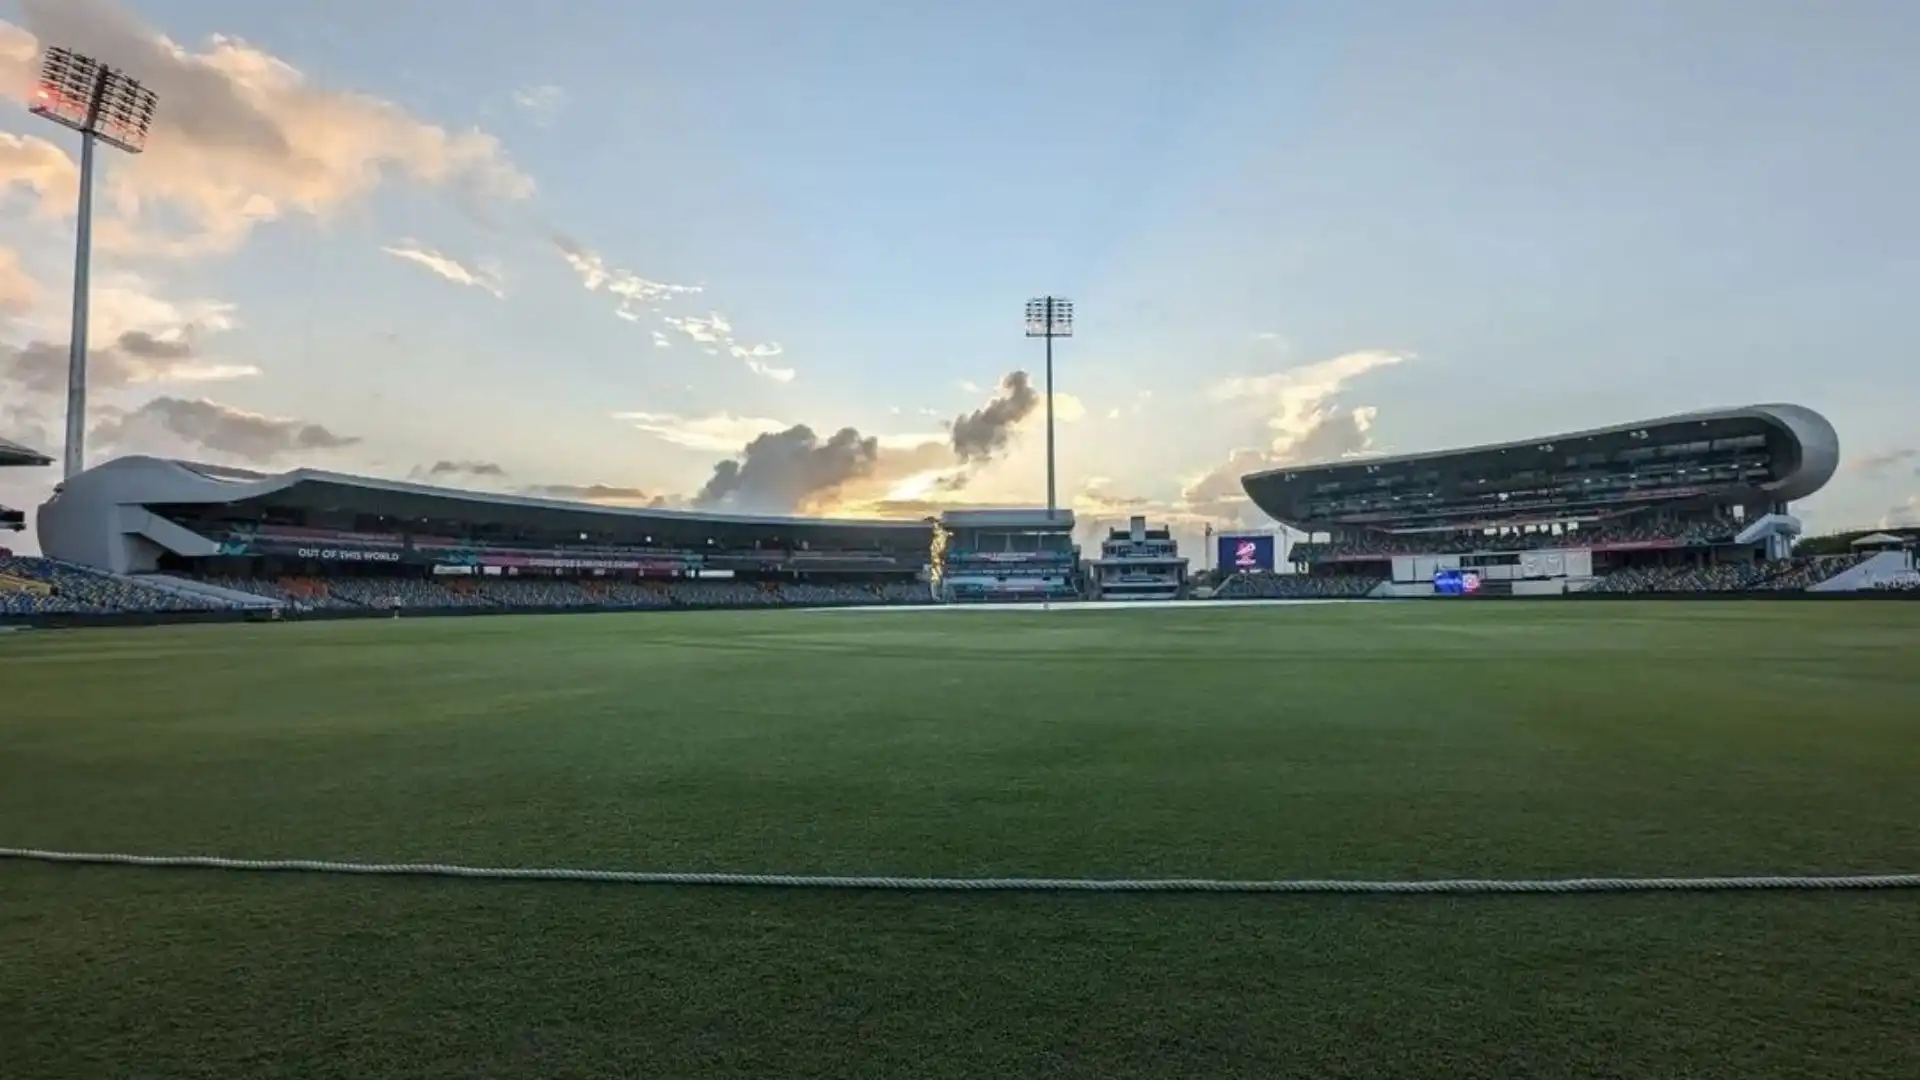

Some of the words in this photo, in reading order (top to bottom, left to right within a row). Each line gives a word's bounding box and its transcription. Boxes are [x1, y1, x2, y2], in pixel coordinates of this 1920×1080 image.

[298, 548, 319, 557] OUT
[321, 549, 337, 559] OF
[340, 550, 361, 560] THIS
[364, 551, 400, 562] WORLD
